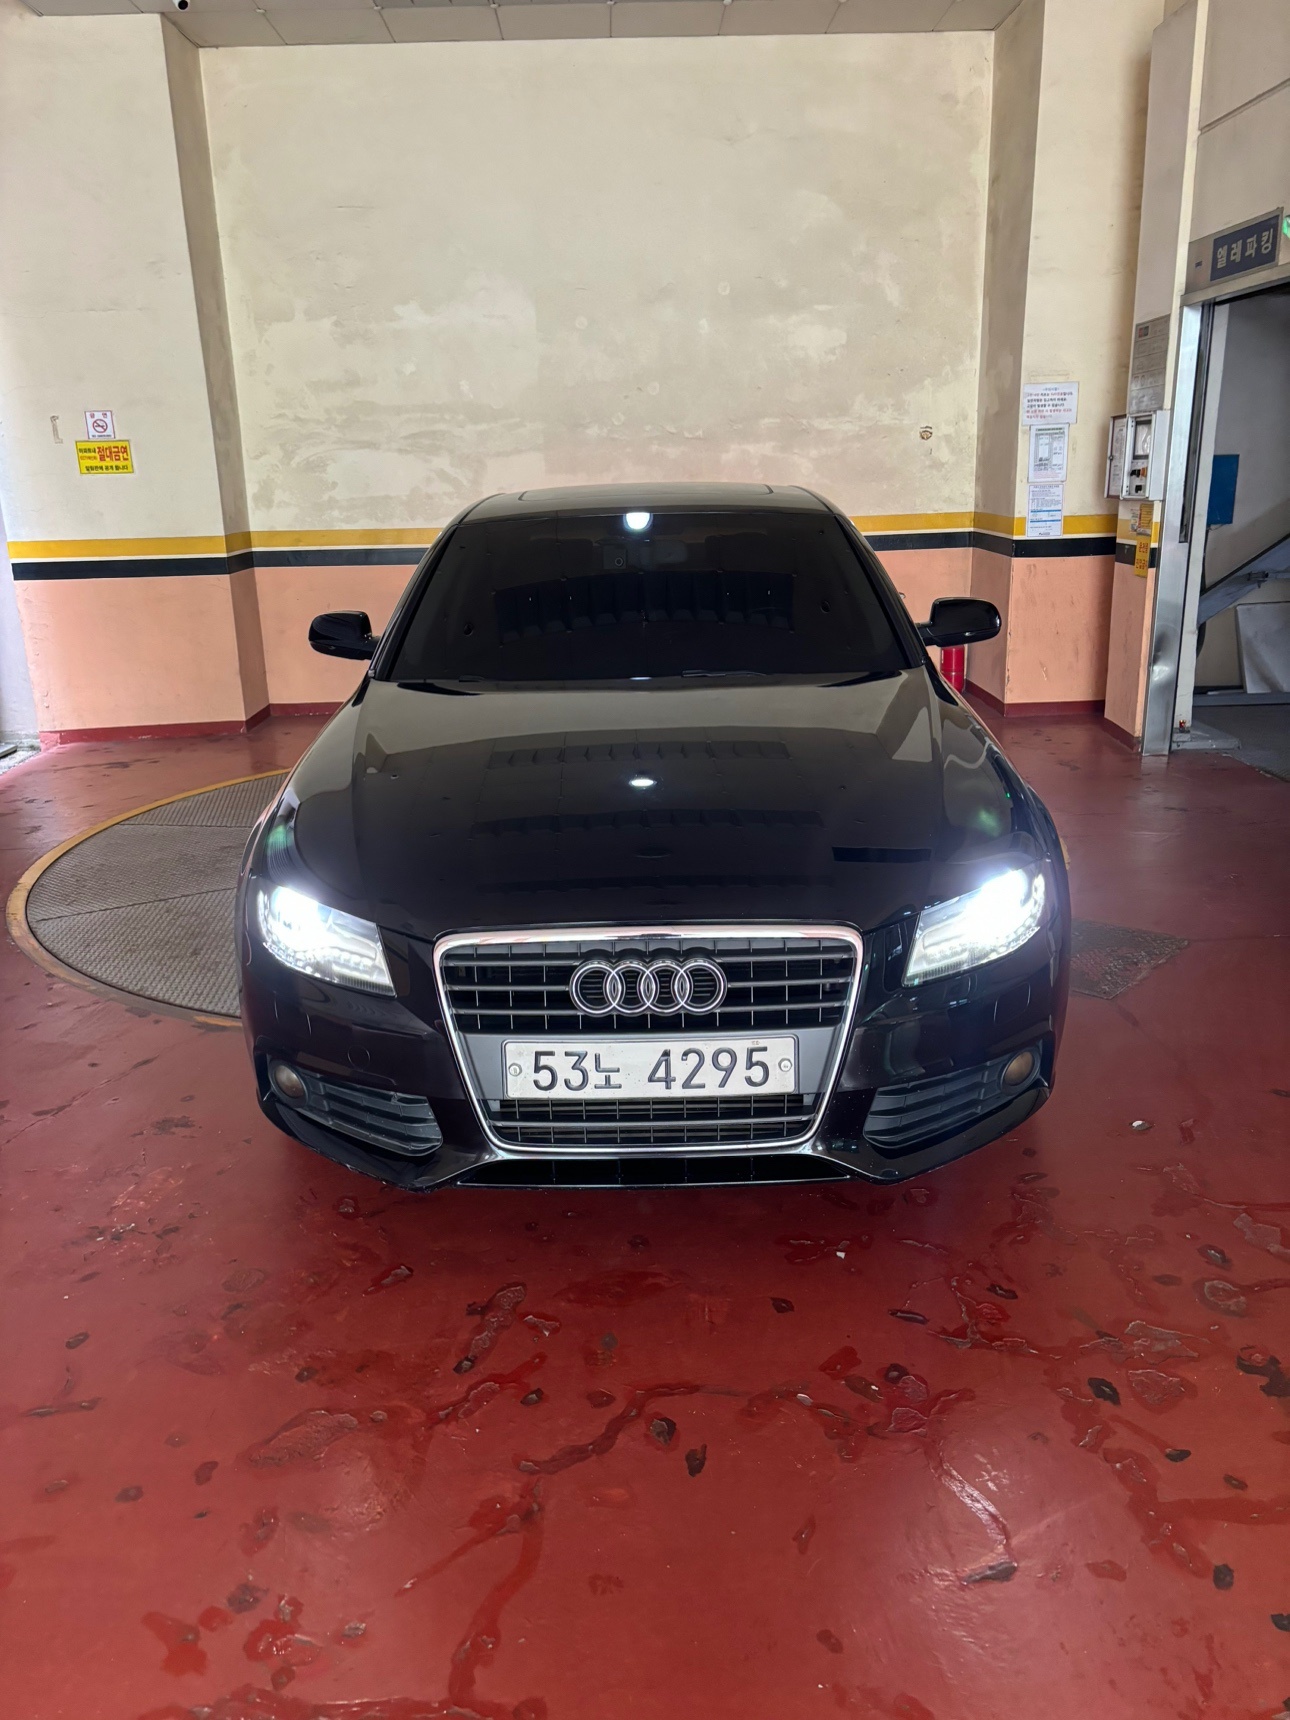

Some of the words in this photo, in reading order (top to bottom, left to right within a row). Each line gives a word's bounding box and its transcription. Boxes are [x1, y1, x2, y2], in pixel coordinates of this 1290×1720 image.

[1216, 227, 1274, 269] 엘레파킹
[97, 445, 129, 461] 절대금연
[533, 1050, 622, 1091] 53노
[647, 1046, 770, 1090] 4295
